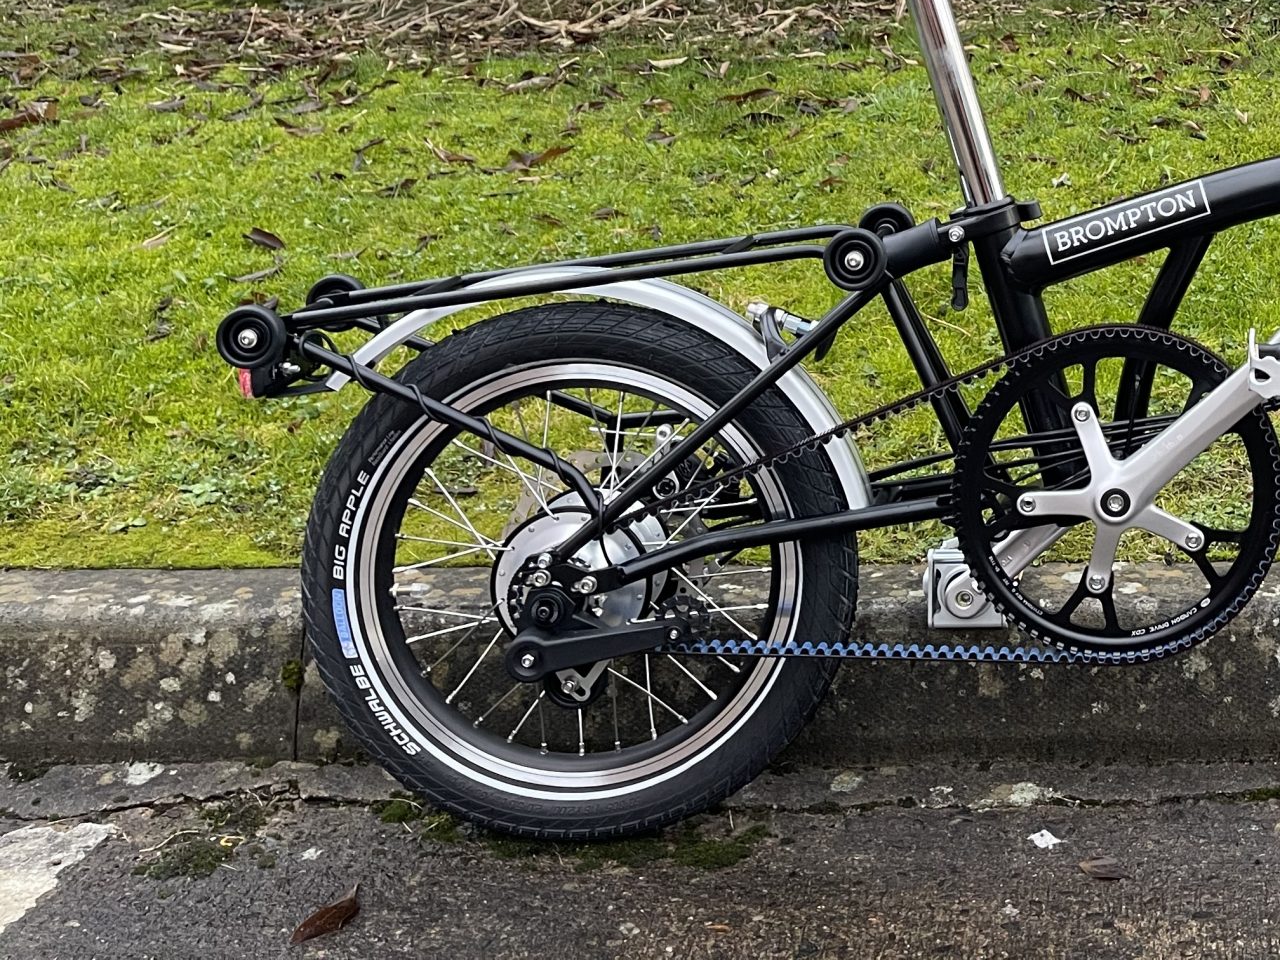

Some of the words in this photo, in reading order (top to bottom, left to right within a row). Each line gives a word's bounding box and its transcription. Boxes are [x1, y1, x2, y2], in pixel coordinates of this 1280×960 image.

[1054, 190, 1197, 252] BROMPTON
[338, 470, 370, 538] APPLE
[333, 543, 347, 580] BIG
[350, 664, 422, 756] SCHWALBE
